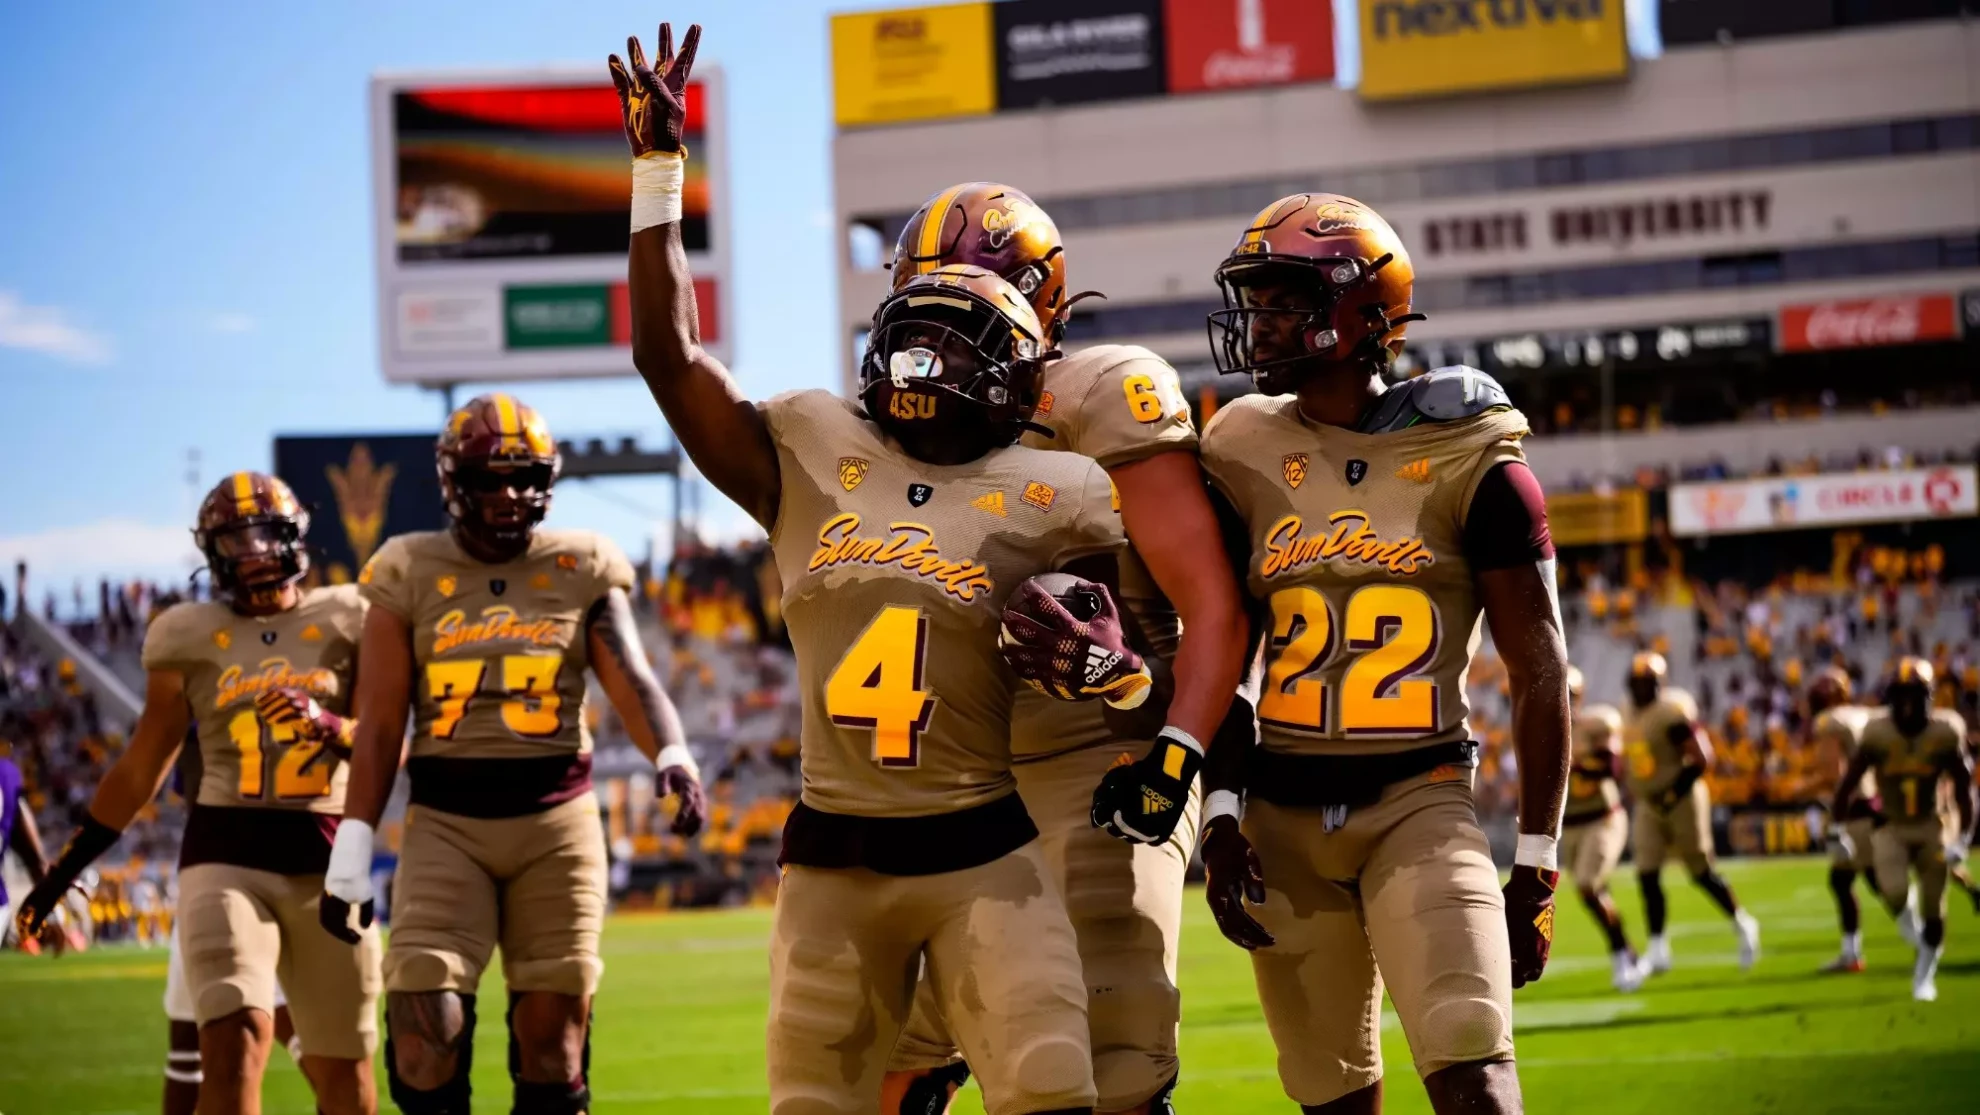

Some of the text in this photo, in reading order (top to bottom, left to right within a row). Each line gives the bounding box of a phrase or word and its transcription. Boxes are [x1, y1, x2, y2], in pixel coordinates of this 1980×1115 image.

[1423, 209, 1529, 257] STATE
[1551, 190, 1772, 246] UNIVERSITY
[889, 391, 938, 420] ASU
[838, 458, 869, 478] PAC
[842, 472, 858, 485] 12
[1283, 453, 1309, 474] PAC
[1287, 469, 1302, 482] 12
[1085, 650, 1124, 684] adidas
[1259, 585, 1441, 736] 22
[426, 655, 563, 739] 73
[825, 604, 936, 769] 4
[229, 709, 332, 799] 12
[1140, 783, 1174, 809] adidas
